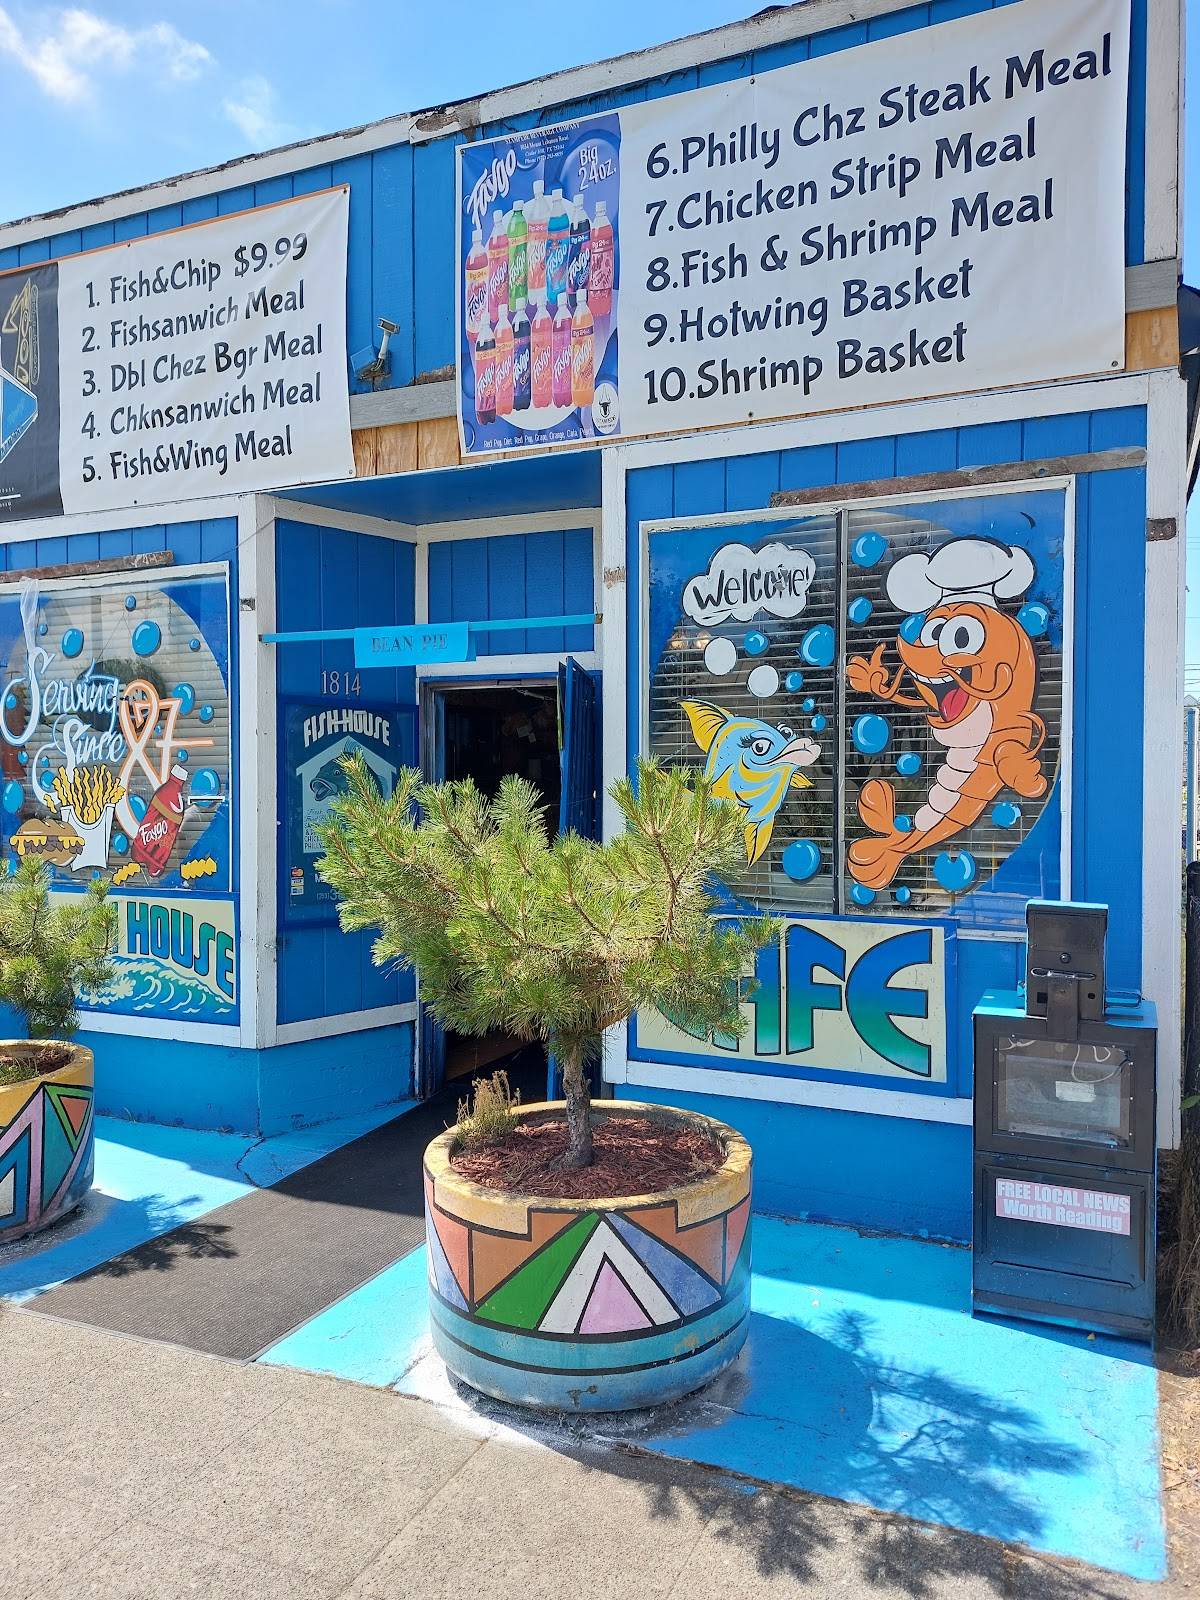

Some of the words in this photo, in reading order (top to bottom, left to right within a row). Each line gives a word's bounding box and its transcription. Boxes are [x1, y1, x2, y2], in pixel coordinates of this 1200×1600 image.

[647, 123, 780, 179] 6.Philly
[793, 104, 865, 146] Chz
[879, 66, 991, 128] Steak
[1005, 32, 1111, 99] Meal
[467, 150, 517, 231] Faygo
[579, 145, 599, 167] Big
[646, 177, 817, 236] 7.Chicken
[831, 154, 920, 200] Strip
[935, 116, 1035, 179] Meal
[86, 282, 100, 308] 1.
[110, 259, 220, 305] Fish&Chip
[235, 233, 307, 278] $9.99
[646, 243, 747, 292] 8.Fish
[761, 235, 788, 271] &
[801, 216, 936, 266] Shrimp
[951, 178, 1053, 237] Meal
[82, 327, 100, 352] 2.
[111, 296, 238, 348] Fishsanwich
[246, 279, 304, 319] Meal
[644, 297, 827, 347] 9.Hotwing
[843, 258, 973, 317] Basket
[83, 370, 100, 396] 3.
[111, 359, 145, 392] Dbl
[153, 354, 206, 383] Chez
[214, 342, 258, 379] Bgr
[264, 323, 322, 363] Meal
[644, 355, 822, 404] 10.Shrimp
[837, 322, 967, 379] Basket
[82, 411, 100, 439] 4.
[111, 385, 254, 434] Chknsanwich
[263, 372, 320, 410] Meal
[83, 456, 101, 482] 5.
[110, 440, 227, 479] Fish&Wing
[235, 424, 292, 462] Meal
[371, 635, 413, 653] BEAN
[422, 633, 448, 652] PIE
[1, 646, 119, 746] Serving
[321, 670, 361, 696] 1814
[139, 820, 168, 846] Faygo
[127, 901, 233, 999] HOUSE
[655, 917, 932, 1077] AFE
[998, 1181, 1031, 1200] FREE
[1034, 1185, 1081, 1207] LOCAL
[1084, 1192, 1130, 1214] NEWS
[1004, 1198, 1052, 1220] Worth
[1056, 1206, 1122, 1231] Reading
